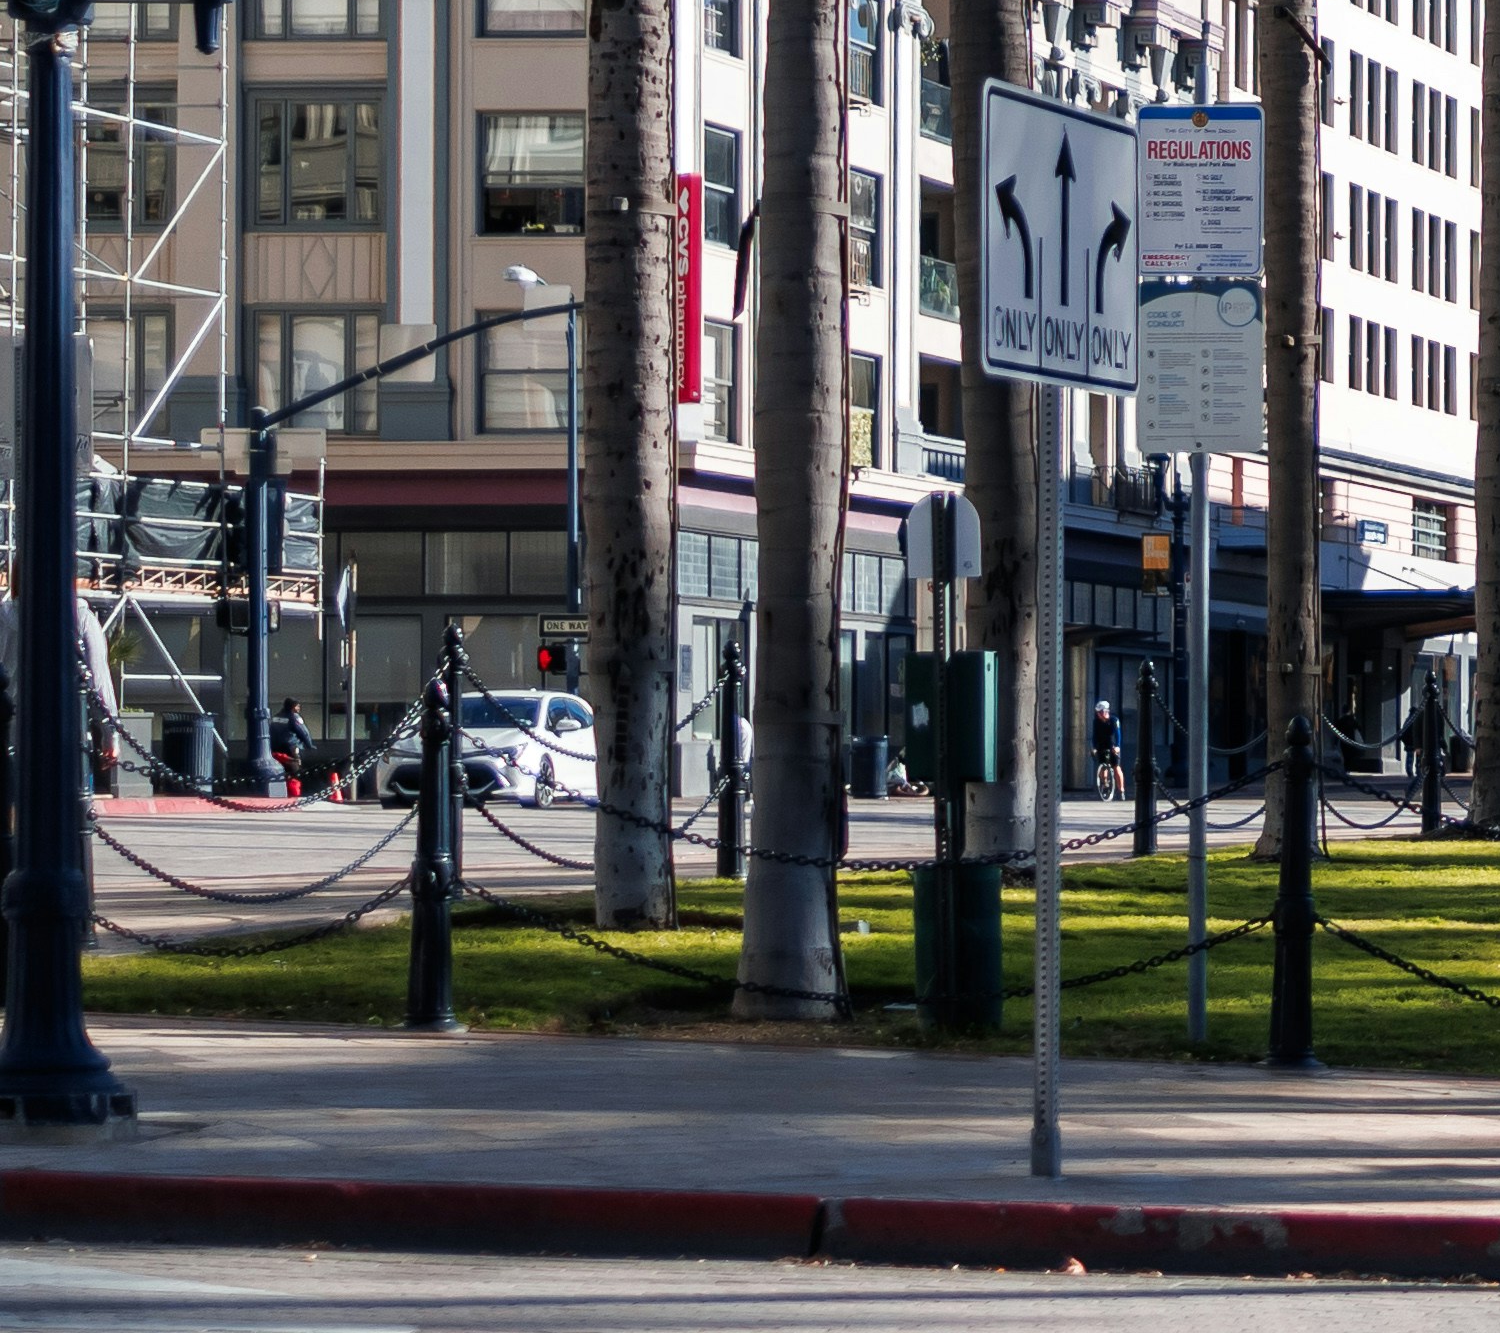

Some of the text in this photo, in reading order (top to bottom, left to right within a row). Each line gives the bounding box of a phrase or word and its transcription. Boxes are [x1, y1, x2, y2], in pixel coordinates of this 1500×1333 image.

[1147, 140, 1252, 160] REGULATIONS
[678, 217, 690, 276] CVS
[677, 280, 688, 389] pharmacy
[994, 305, 1037, 352] ONLY
[1044, 316, 1085, 361] ONLY
[1092, 325, 1132, 370] ONLY
[546, 622, 588, 630] ONE WAY
